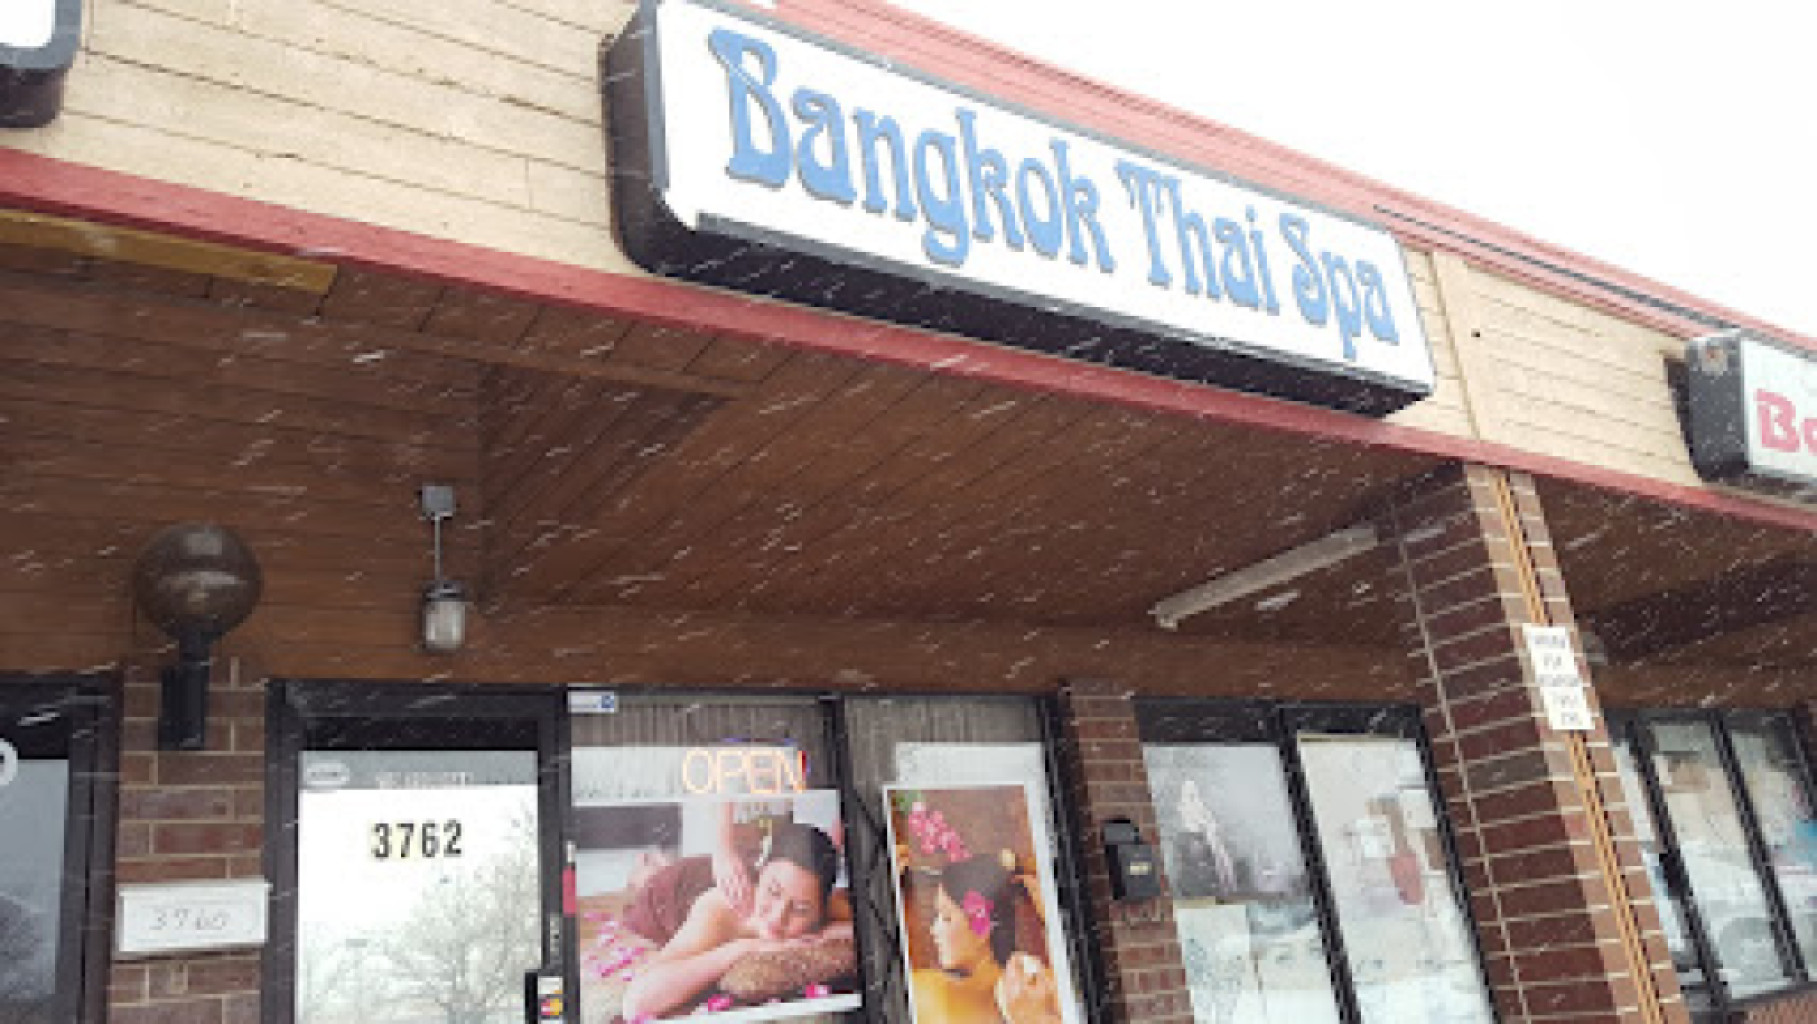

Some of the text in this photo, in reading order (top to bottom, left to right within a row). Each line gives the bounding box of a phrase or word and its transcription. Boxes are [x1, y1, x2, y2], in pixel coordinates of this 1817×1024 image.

[708, 26, 1400, 361] Bangkok Thai Spa
[682, 748, 808, 794] OPEN
[371, 818, 463, 860] 3762
